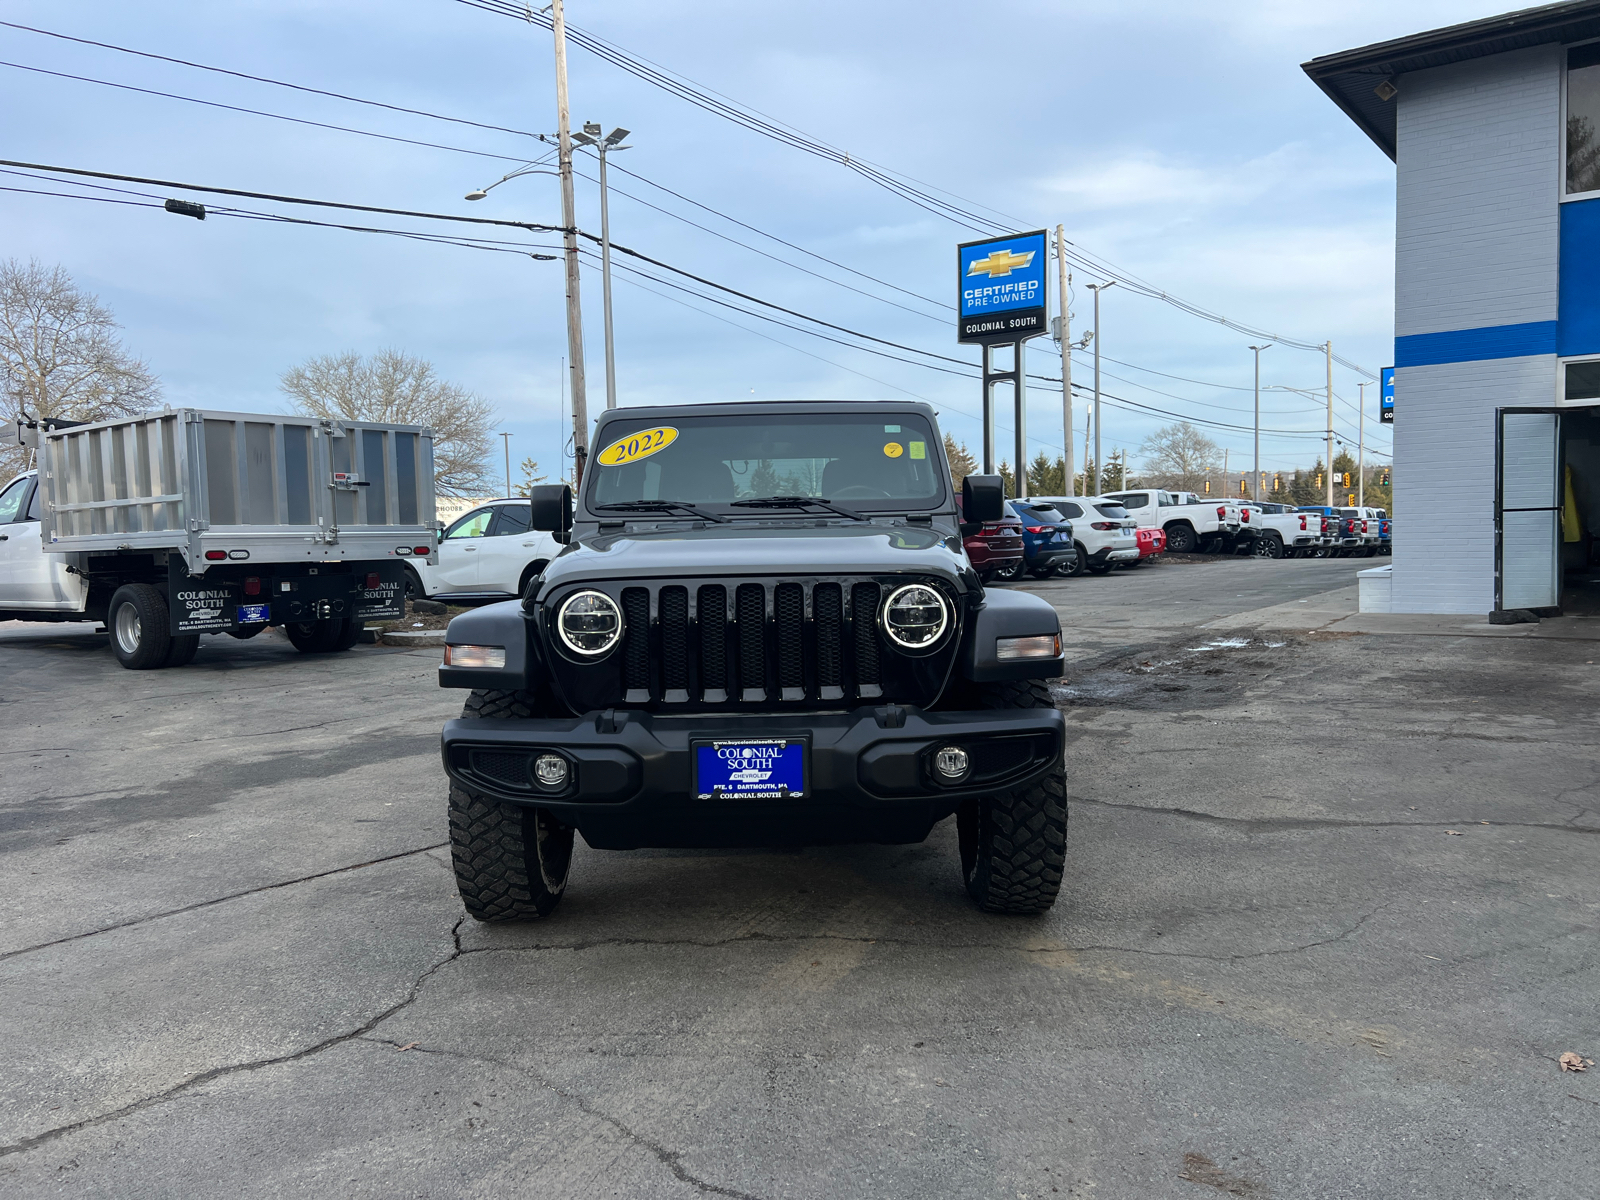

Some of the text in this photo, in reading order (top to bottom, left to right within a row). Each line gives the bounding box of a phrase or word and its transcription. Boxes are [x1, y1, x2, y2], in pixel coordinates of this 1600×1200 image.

[964, 280, 1038, 299] CERTIFIED
[968, 290, 1035, 308] PRE-OWNED
[966, 316, 1037, 333] COLONIAL SOUTH
[614, 430, 664, 463] 2022
[177, 590, 231, 600] COLONIAL
[364, 590, 394, 598] SOUTH
[185, 599, 224, 609] SOUTH
[717, 747, 783, 759] COLONIAL
[727, 758, 773, 769] SOUTH
